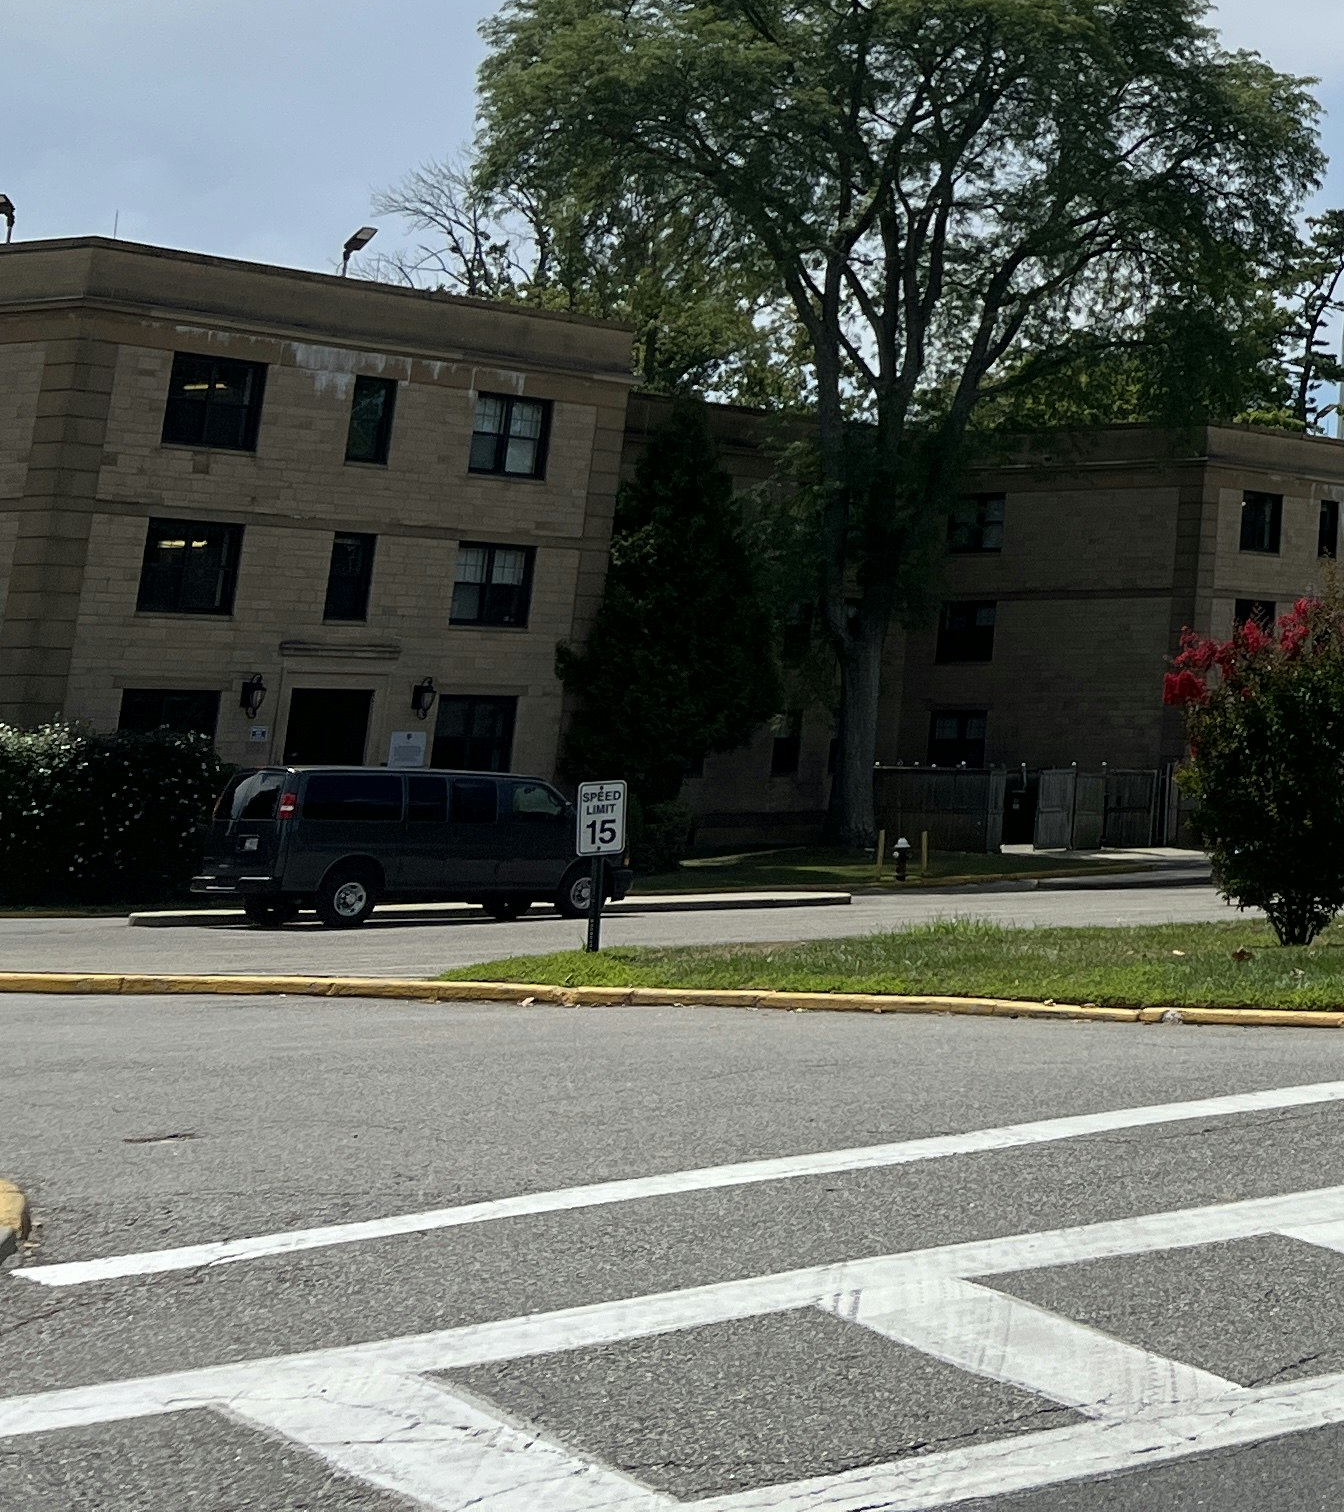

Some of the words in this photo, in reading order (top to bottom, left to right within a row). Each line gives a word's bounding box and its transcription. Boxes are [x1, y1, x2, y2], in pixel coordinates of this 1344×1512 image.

[583, 791, 621, 802] SPEED
[587, 804, 616, 815] LIMIT
[587, 819, 616, 844] 15
